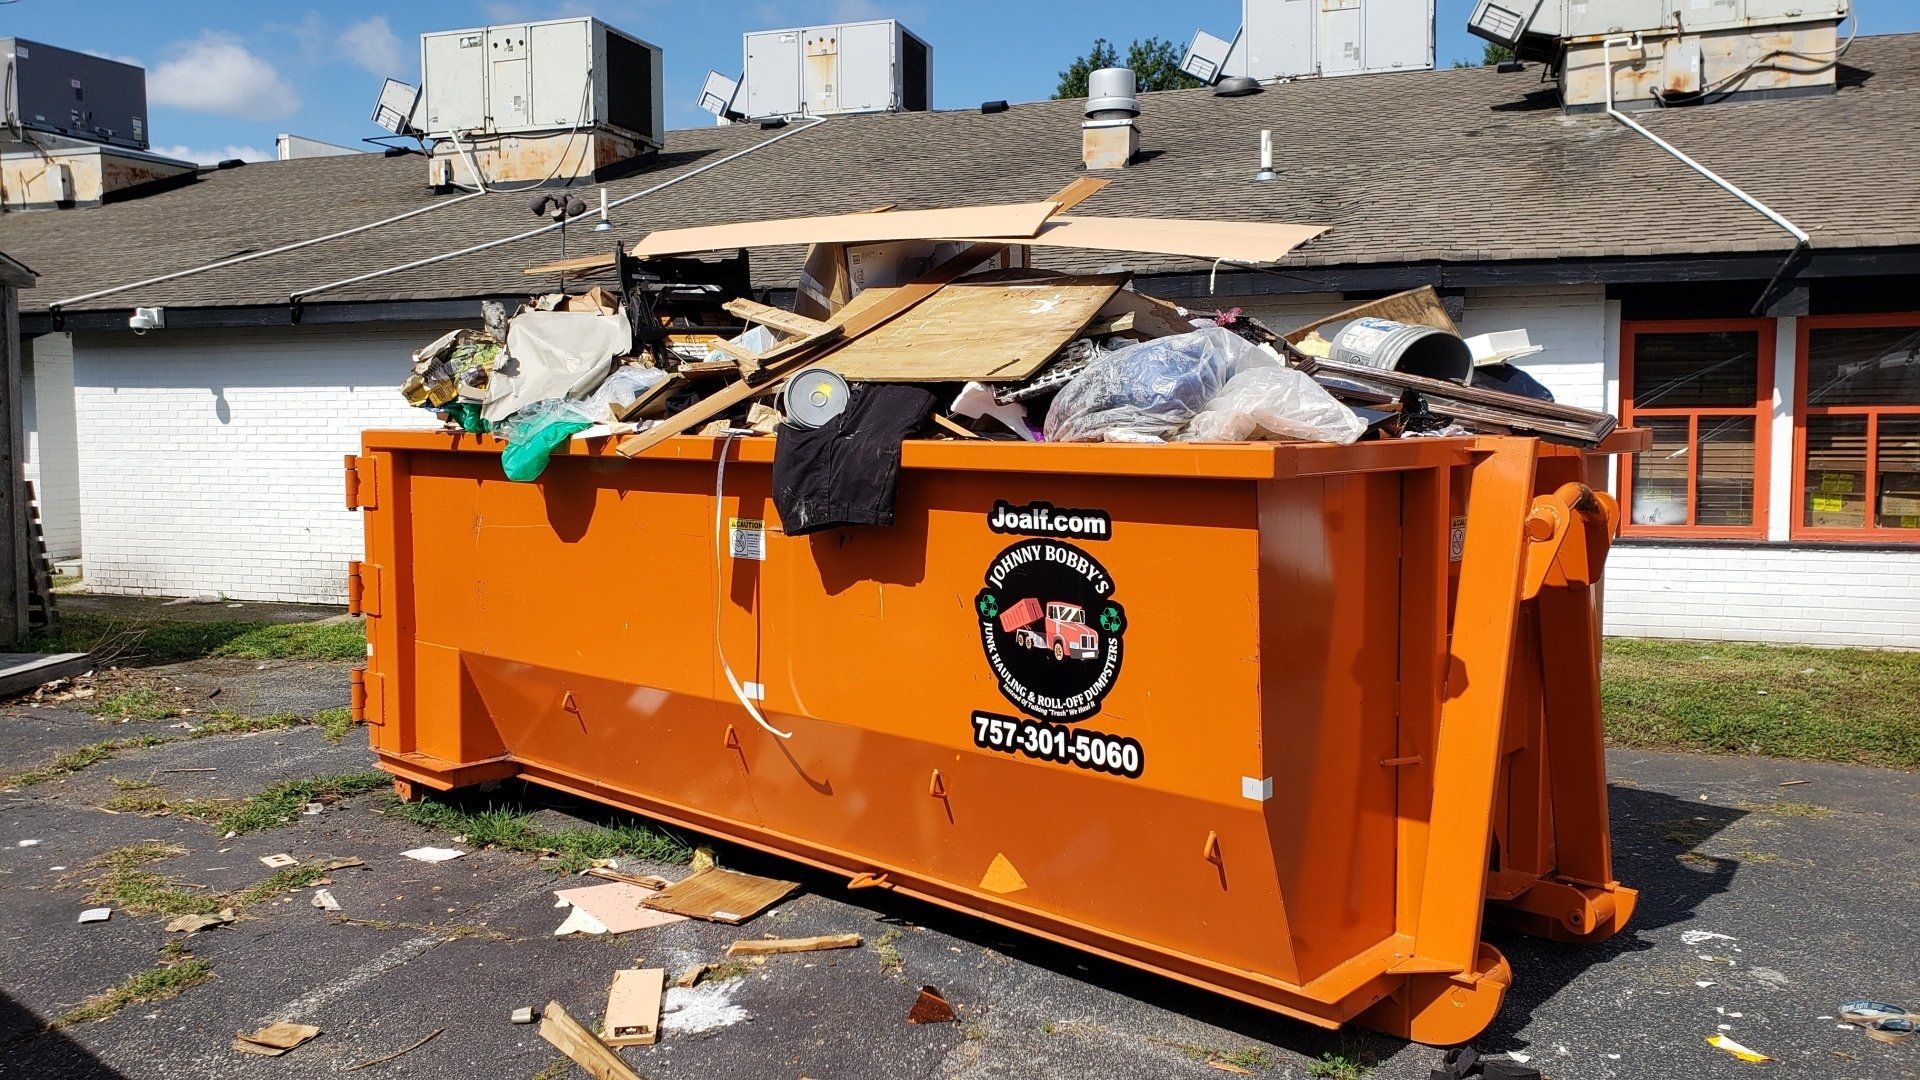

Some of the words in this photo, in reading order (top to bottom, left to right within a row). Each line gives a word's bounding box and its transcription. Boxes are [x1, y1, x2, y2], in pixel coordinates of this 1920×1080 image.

[736, 520, 763, 529] CAUTION
[989, 544, 1042, 590] JOHNNY
[1045, 545, 1110, 594] BOBBY'S
[983, 621, 997, 654] JUNK
[991, 652, 1028, 697] HAULING
[1027, 691, 1036, 703] &
[1037, 693, 1084, 709] ROLL-OFF
[1084, 637, 1118, 702] DUMPSTERS
[1002, 683, 1022, 702] Instead
[1027, 702, 1048, 716] Talking
[1048, 708, 1069, 717] "Trash"
[1069, 708, 1078, 716] We
[1078, 703, 1091, 714] Haul
[975, 716, 1139, 772] 757-301-5060
